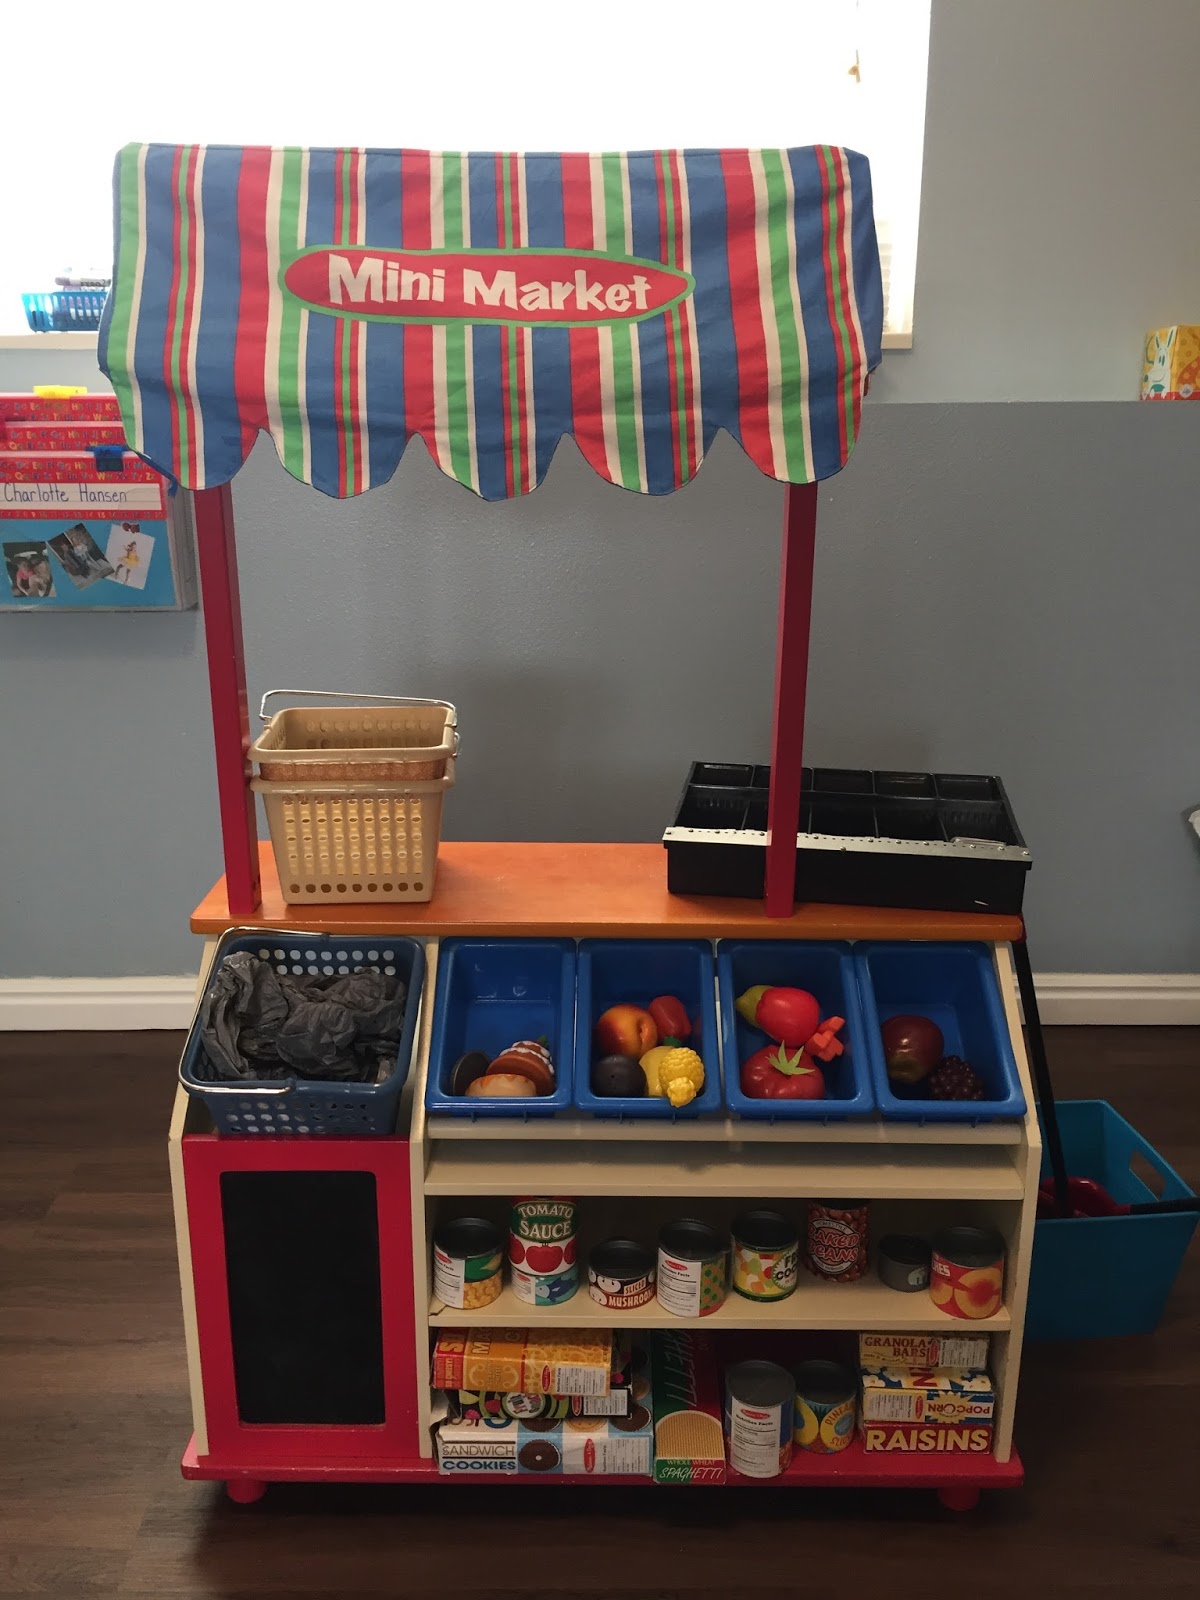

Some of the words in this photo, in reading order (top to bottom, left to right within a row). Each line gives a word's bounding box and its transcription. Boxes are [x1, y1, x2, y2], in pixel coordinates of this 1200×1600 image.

[327, 252, 446, 305] Mini
[462, 268, 653, 312] Market
[4, 483, 69, 502] Charlotte
[79, 482, 128, 502] Hansen
[518, 1204, 574, 1218] TOMATO
[518, 1220, 572, 1239] SAUCE
[864, 1336, 927, 1348] GRANOLA
[892, 1347, 926, 1358] BARS
[928, 1402, 990, 1415] POPCORN
[866, 1429, 989, 1451] RAISINS
[442, 1445, 515, 1456] SANDWICH
[442, 1460, 516, 1470] COOKIES
[659, 1466, 724, 1482] SPAGHETTI
